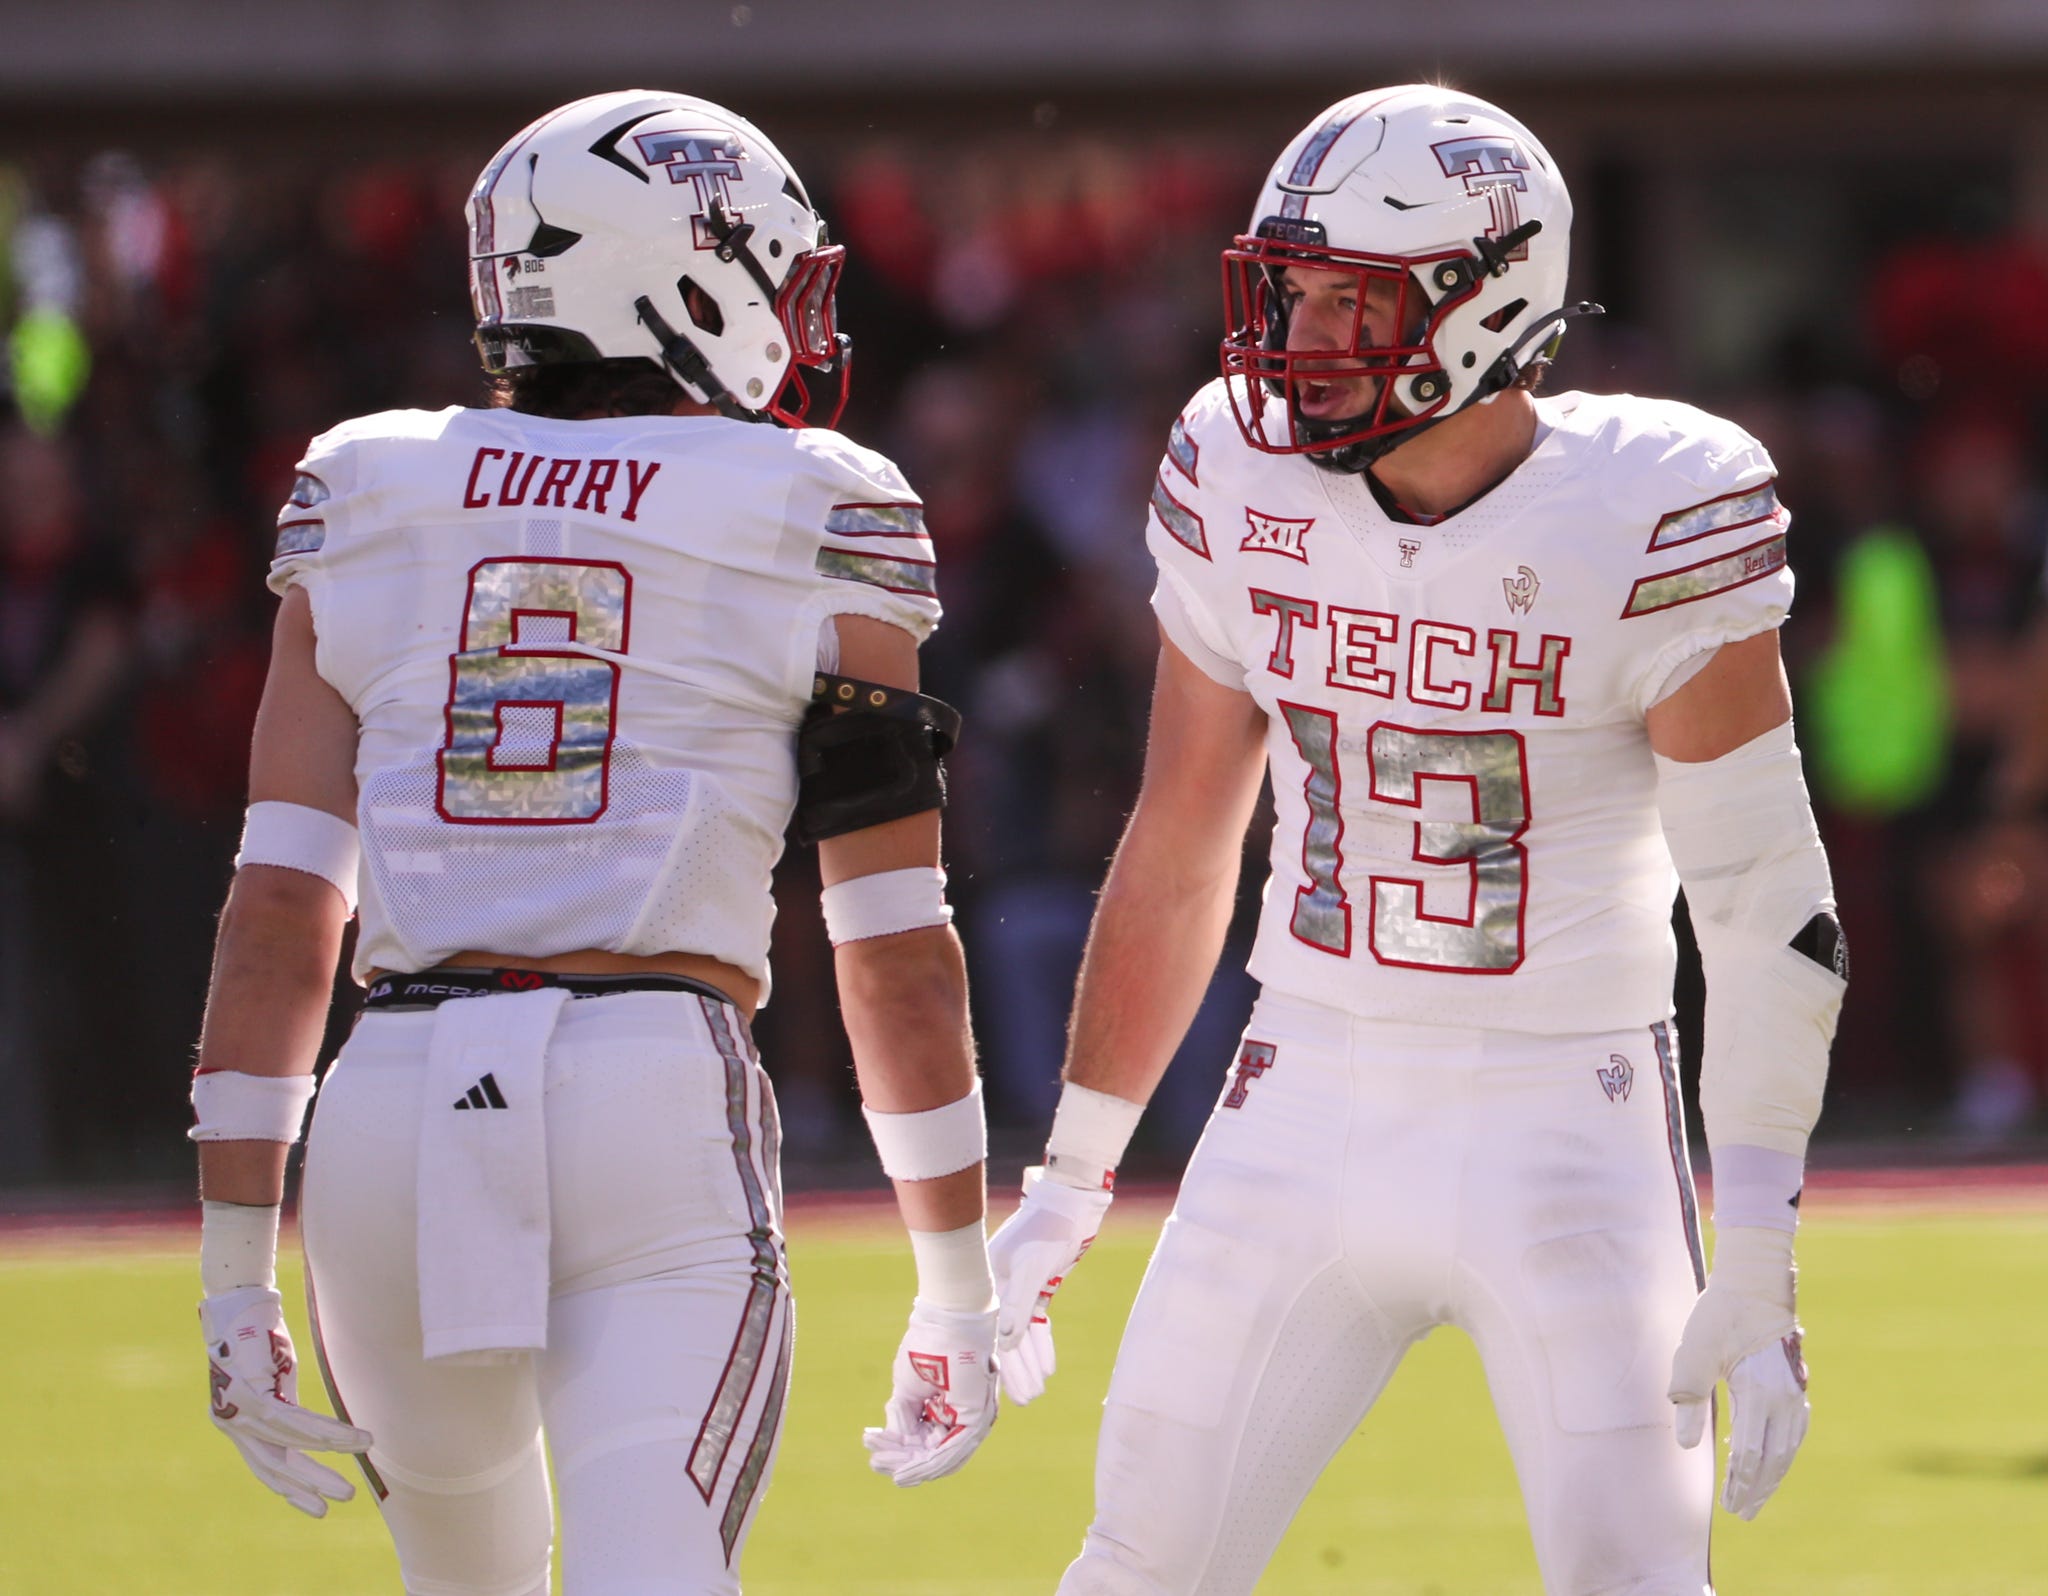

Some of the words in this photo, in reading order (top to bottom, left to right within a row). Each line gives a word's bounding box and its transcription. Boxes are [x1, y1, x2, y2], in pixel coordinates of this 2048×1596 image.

[524, 259, 545, 274] 806
[462, 447, 661, 522] CURRY
[1248, 587, 1572, 718] TECH
[1276, 698, 1532, 976] 13
